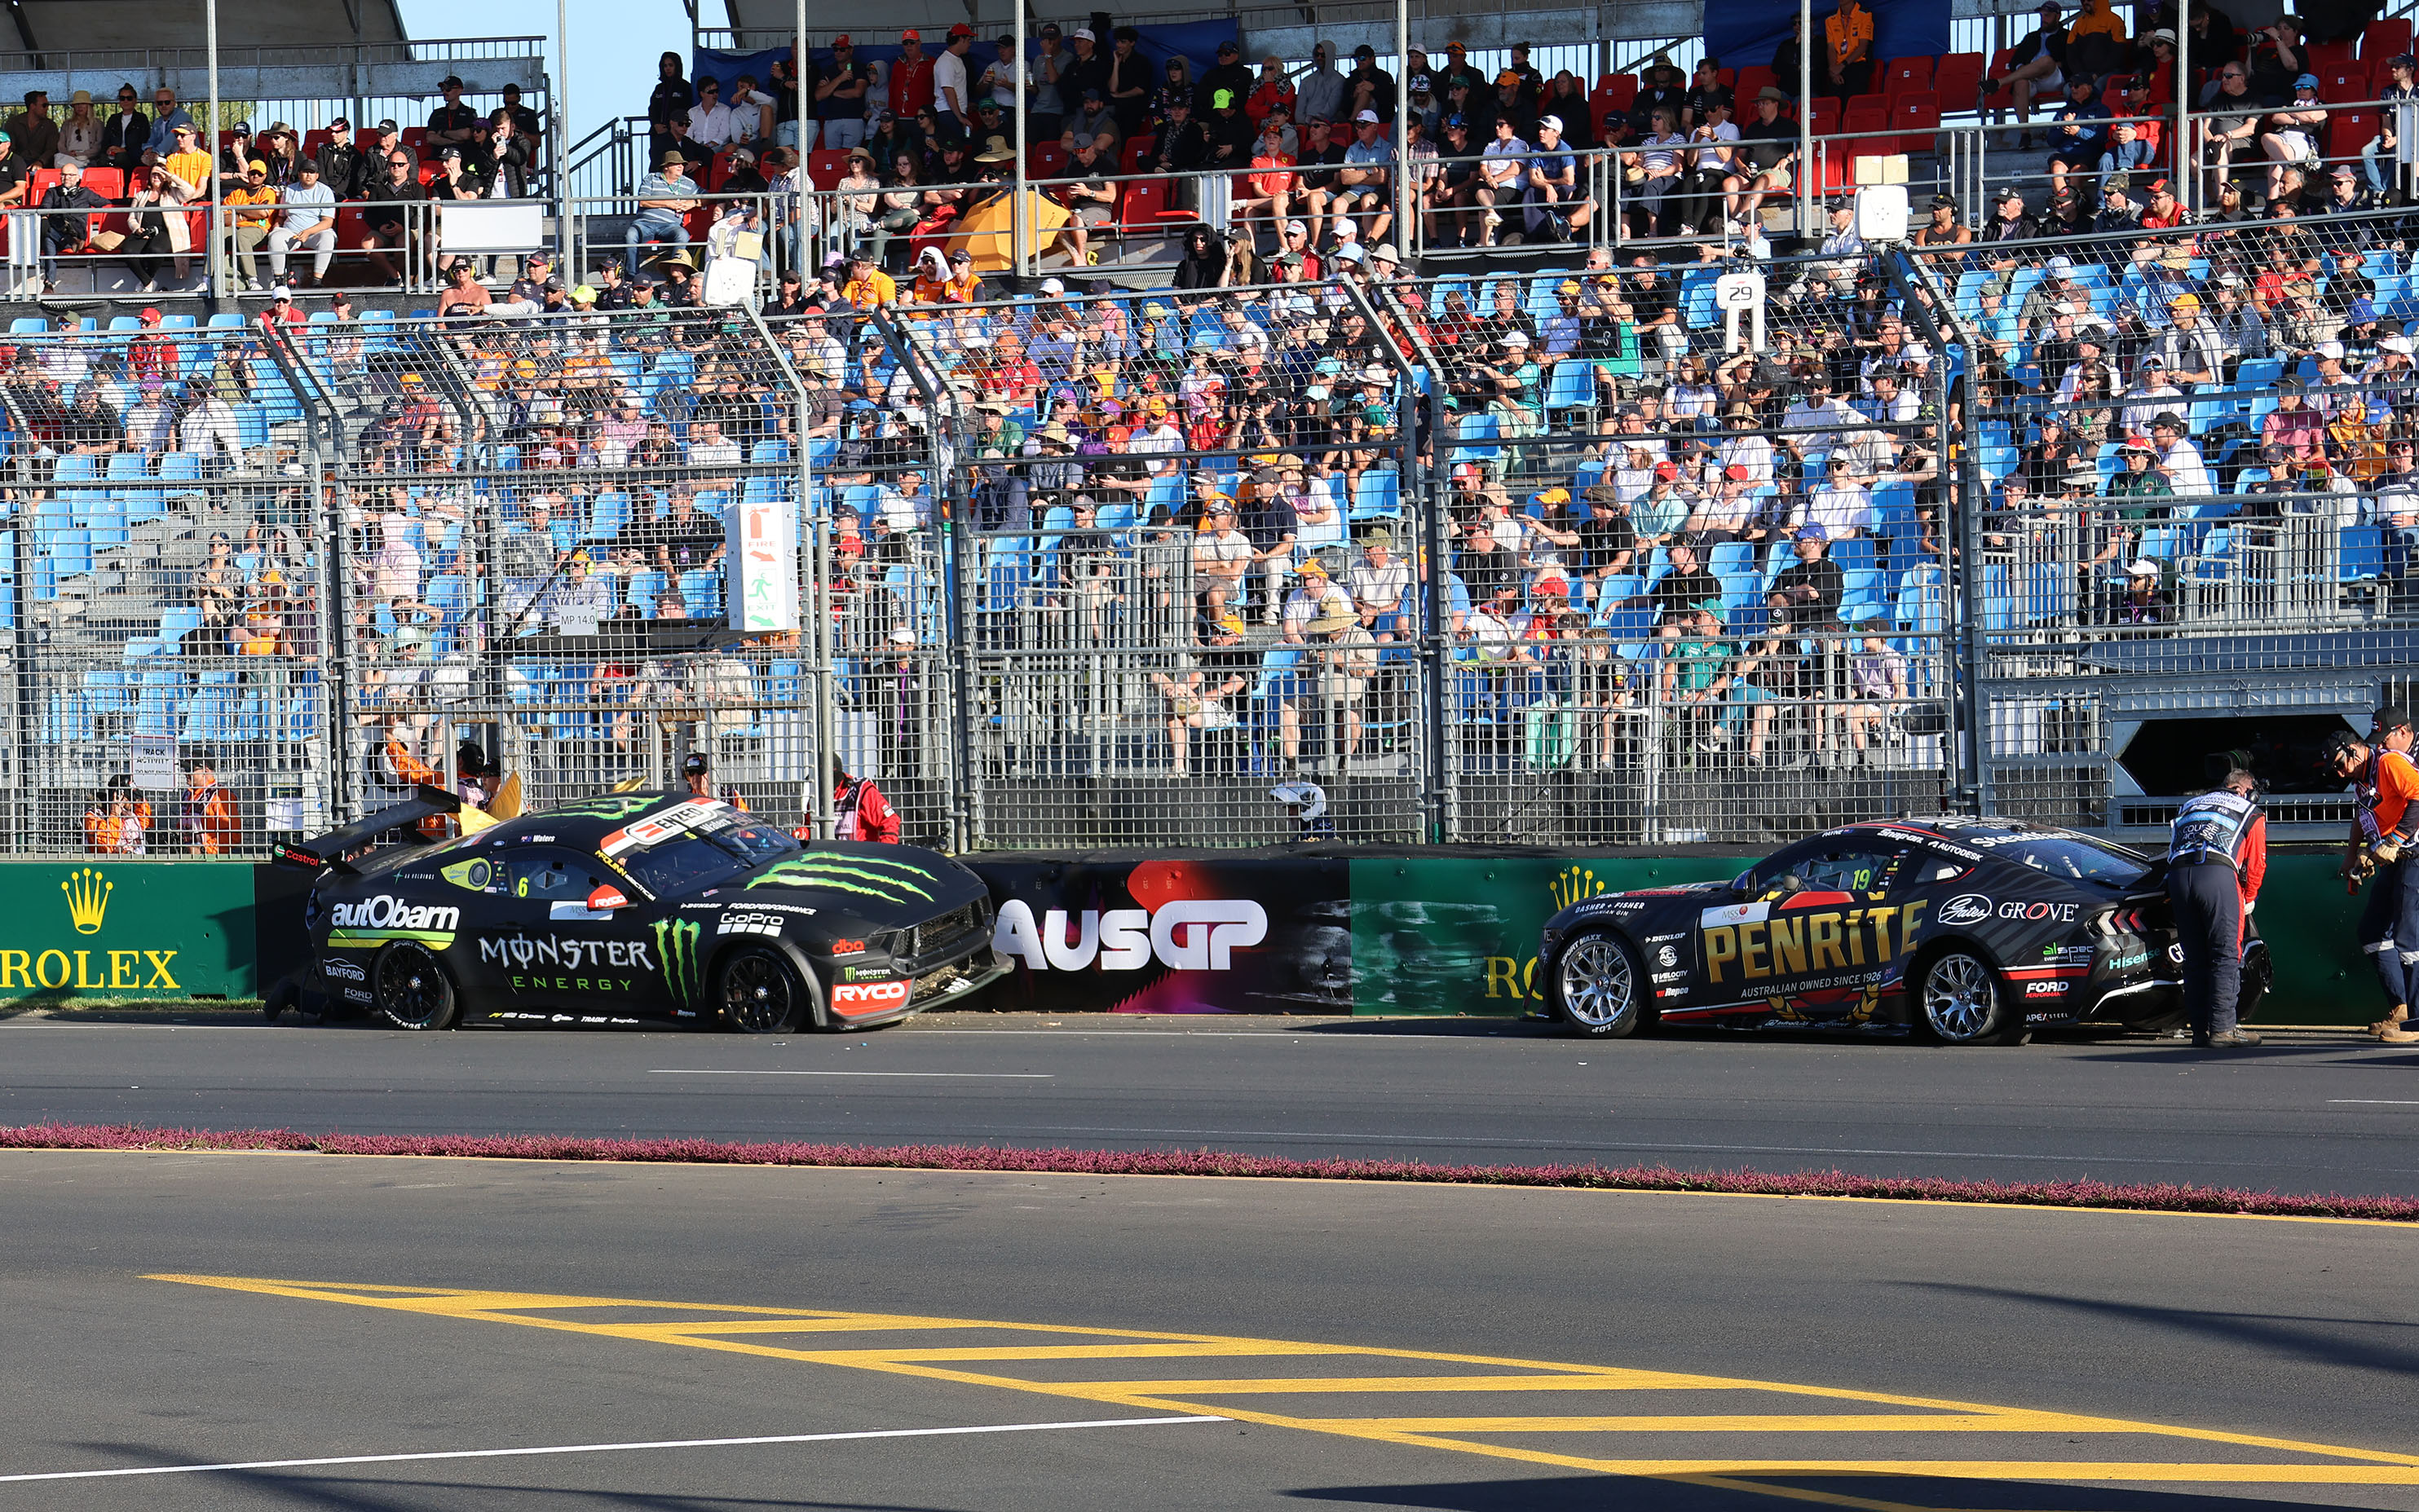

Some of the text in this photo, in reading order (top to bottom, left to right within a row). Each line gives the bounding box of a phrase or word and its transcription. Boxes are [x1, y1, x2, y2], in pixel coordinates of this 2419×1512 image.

[1729, 287, 1752, 301] 29
[561, 615, 595, 624] MP 14.0
[532, 835, 556, 843] Waters
[285, 849, 319, 866] Castrol
[1937, 842, 1984, 862] AUTODESK
[1852, 869, 1871, 890] 19
[518, 877, 528, 897] 6
[594, 895, 627, 907] RYCO
[1574, 902, 1605, 914] DASHER
[1614, 901, 1645, 910] FISHER
[1721, 909, 1739, 919] MSS
[1940, 897, 1989, 922] Gates
[720, 912, 784, 926] GoPro
[1651, 932, 1686, 942] DUNLOP
[832, 938, 866, 954] dba
[1560, 933, 1602, 967] SPORT MAXX
[1659, 952, 1678, 960] ACL
[2108, 948, 2161, 970] Hisense
[0, 949, 181, 989] ROLEX
[325, 965, 365, 981] BAYFORD
[1658, 970, 1688, 980] VELOCITY
[513, 976, 631, 991] ENERGY
[1741, 971, 1883, 998] AUSTRALIAN OWNED SINCE 1926
[2026, 981, 2069, 993] FORD
[344, 987, 373, 999] FORD
[834, 982, 906, 1002] RYCO
[1664, 986, 1689, 998] Repco
[580, 1016, 608, 1024] TRADIE
[677, 1009, 696, 1017] Repco
